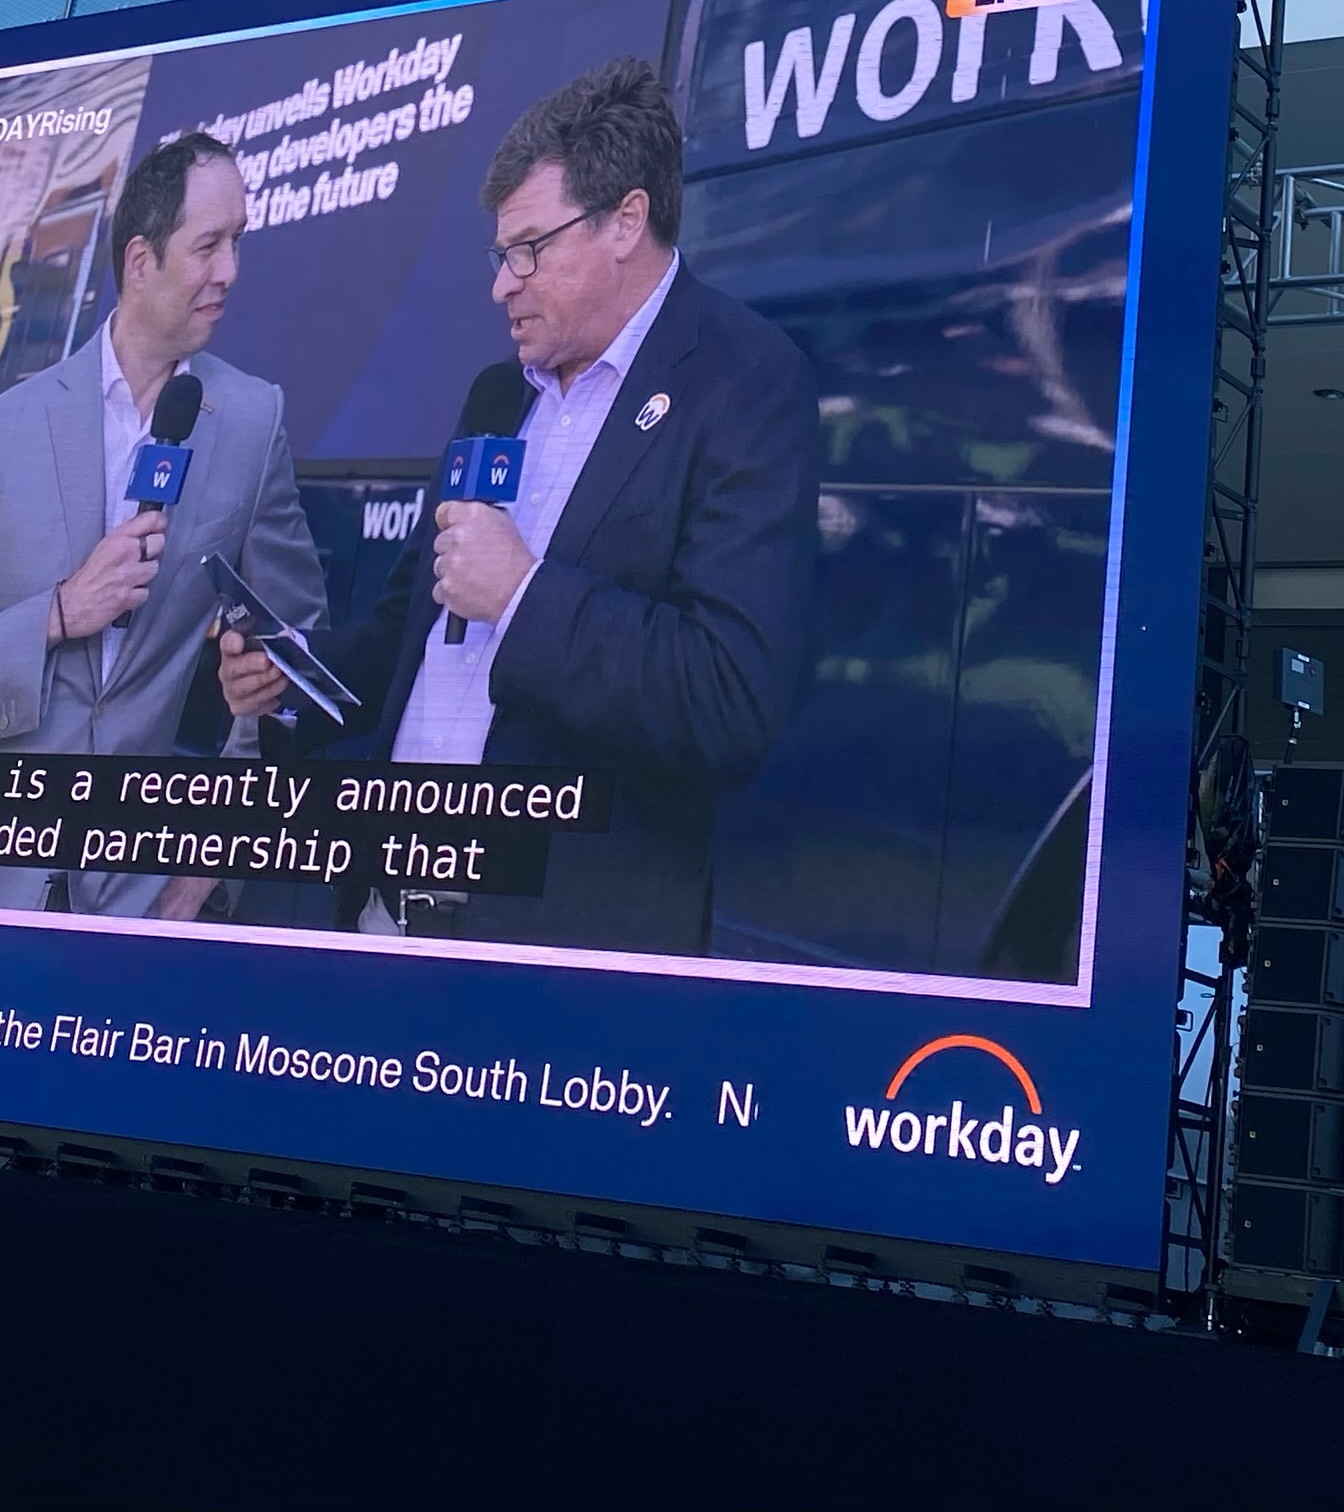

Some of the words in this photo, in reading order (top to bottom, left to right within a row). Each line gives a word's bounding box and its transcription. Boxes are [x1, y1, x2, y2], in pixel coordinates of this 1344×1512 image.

[245, 77, 331, 140] unveils
[332, 33, 463, 109] Workday
[268, 101, 417, 179] developers
[419, 83, 474, 133] the
[267, 181, 311, 227] the
[311, 161, 400, 216] future
[4, 759, 47, 800] is
[71, 769, 92, 802] a
[119, 766, 311, 818] recently
[336, 774, 584, 820] announced
[80, 821, 353, 882] partnership
[380, 832, 486, 881] that
[51, 1015, 124, 1060] Flair
[129, 1023, 190, 1067] Bar
[194, 1027, 226, 1071] in
[234, 1032, 403, 1089] Moscone
[412, 1050, 528, 1103] South
[539, 1062, 675, 1127] Lobby.
[718, 1080, 759, 1128] N
[844, 1100, 1081, 1185] workday
